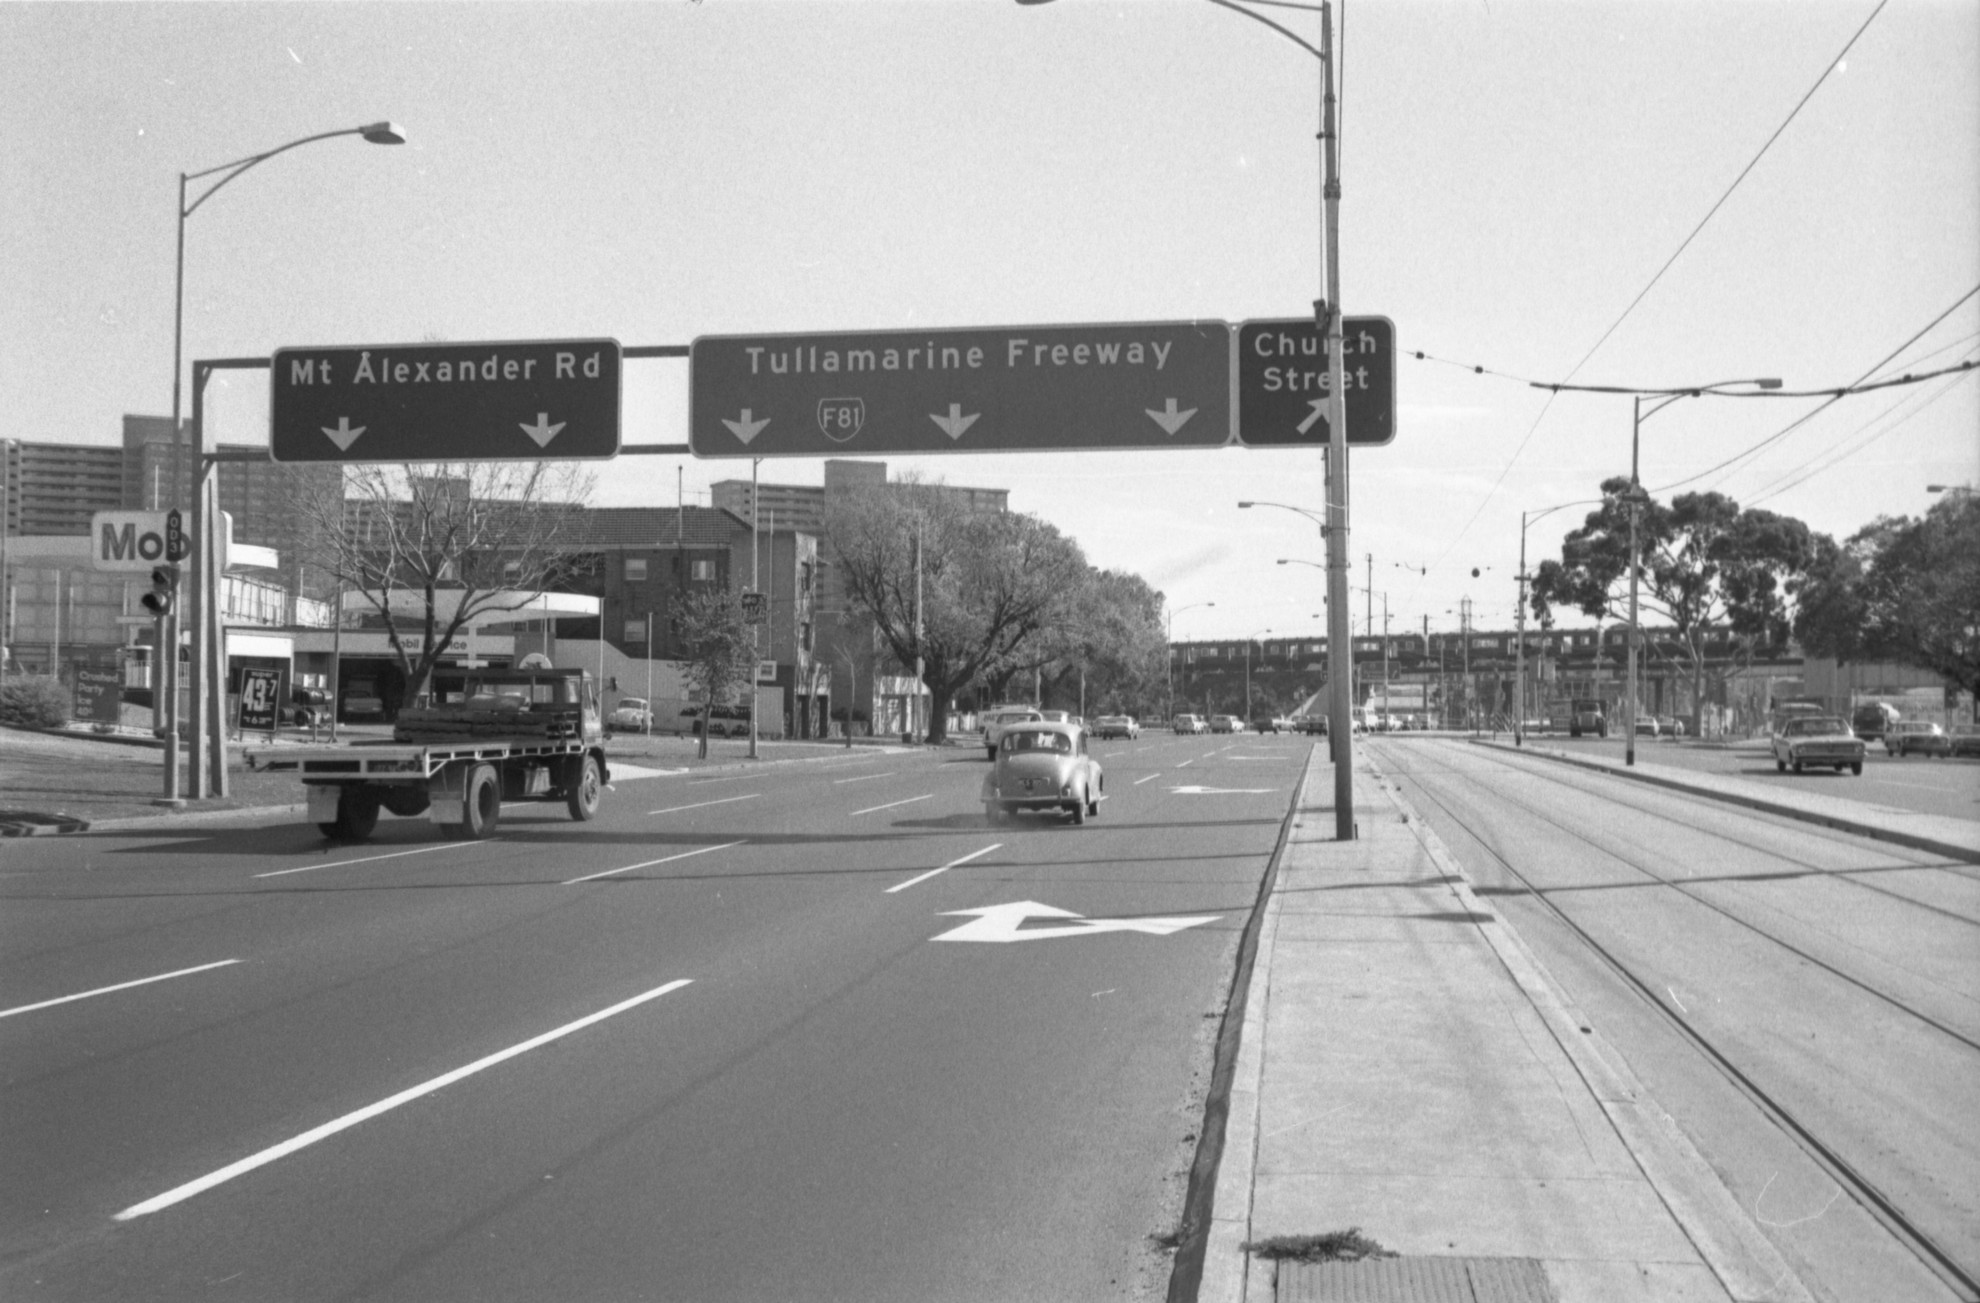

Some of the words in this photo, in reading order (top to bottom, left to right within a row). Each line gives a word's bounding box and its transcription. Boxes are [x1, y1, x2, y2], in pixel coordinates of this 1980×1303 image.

[291, 359, 332, 385] Mt
[353, 352, 537, 384] Alexander
[556, 352, 600, 379] Rd
[745, 340, 984, 375] Tullamarine
[1008, 338, 1172, 370] Freeway
[1263, 366, 1369, 391] Street
[823, 407, 859, 429] F81
[78, 682, 104, 696] Party
